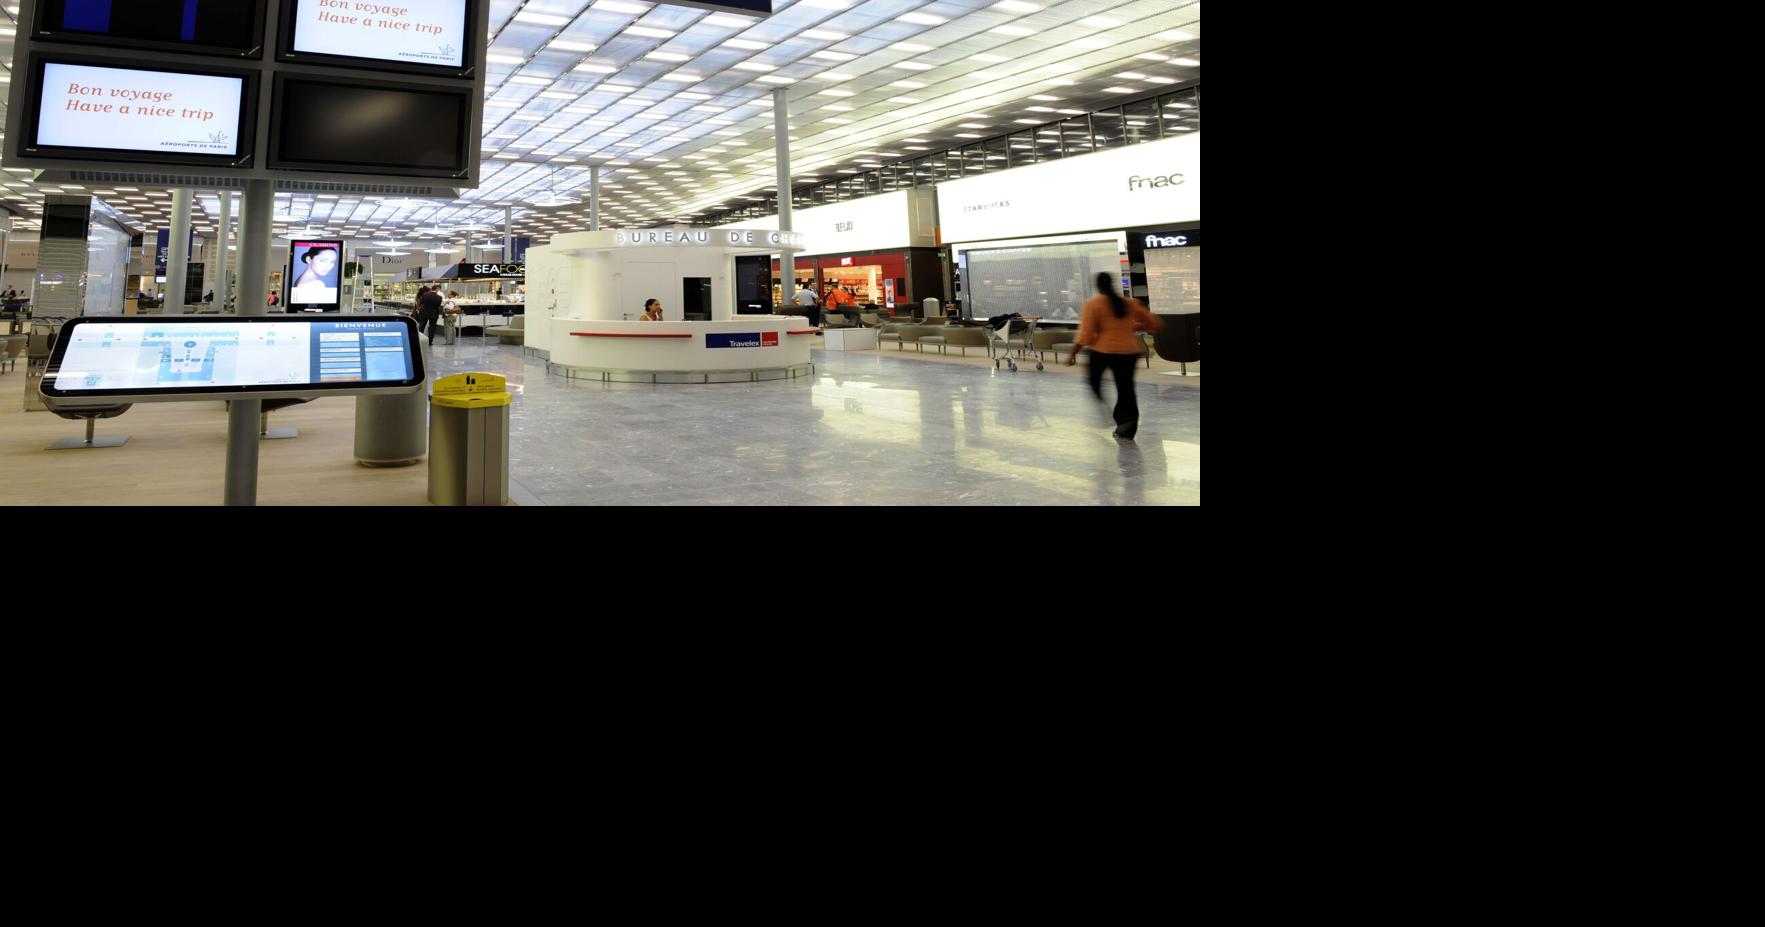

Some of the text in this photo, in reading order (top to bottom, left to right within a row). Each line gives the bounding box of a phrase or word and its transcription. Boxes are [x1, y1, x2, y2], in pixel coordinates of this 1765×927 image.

[319, 0, 408, 17] Bon voyage
[318, 11, 443, 36] Have a nice trip
[67, 83, 173, 102] Bon voyage
[65, 100, 214, 122] Have a nice trip
[1128, 173, 1185, 191] fnac
[616, 231, 708, 243] BUREAU
[730, 232, 753, 243] DE
[1145, 235, 1187, 248] fnac
[729, 340, 760, 348] Travelex
